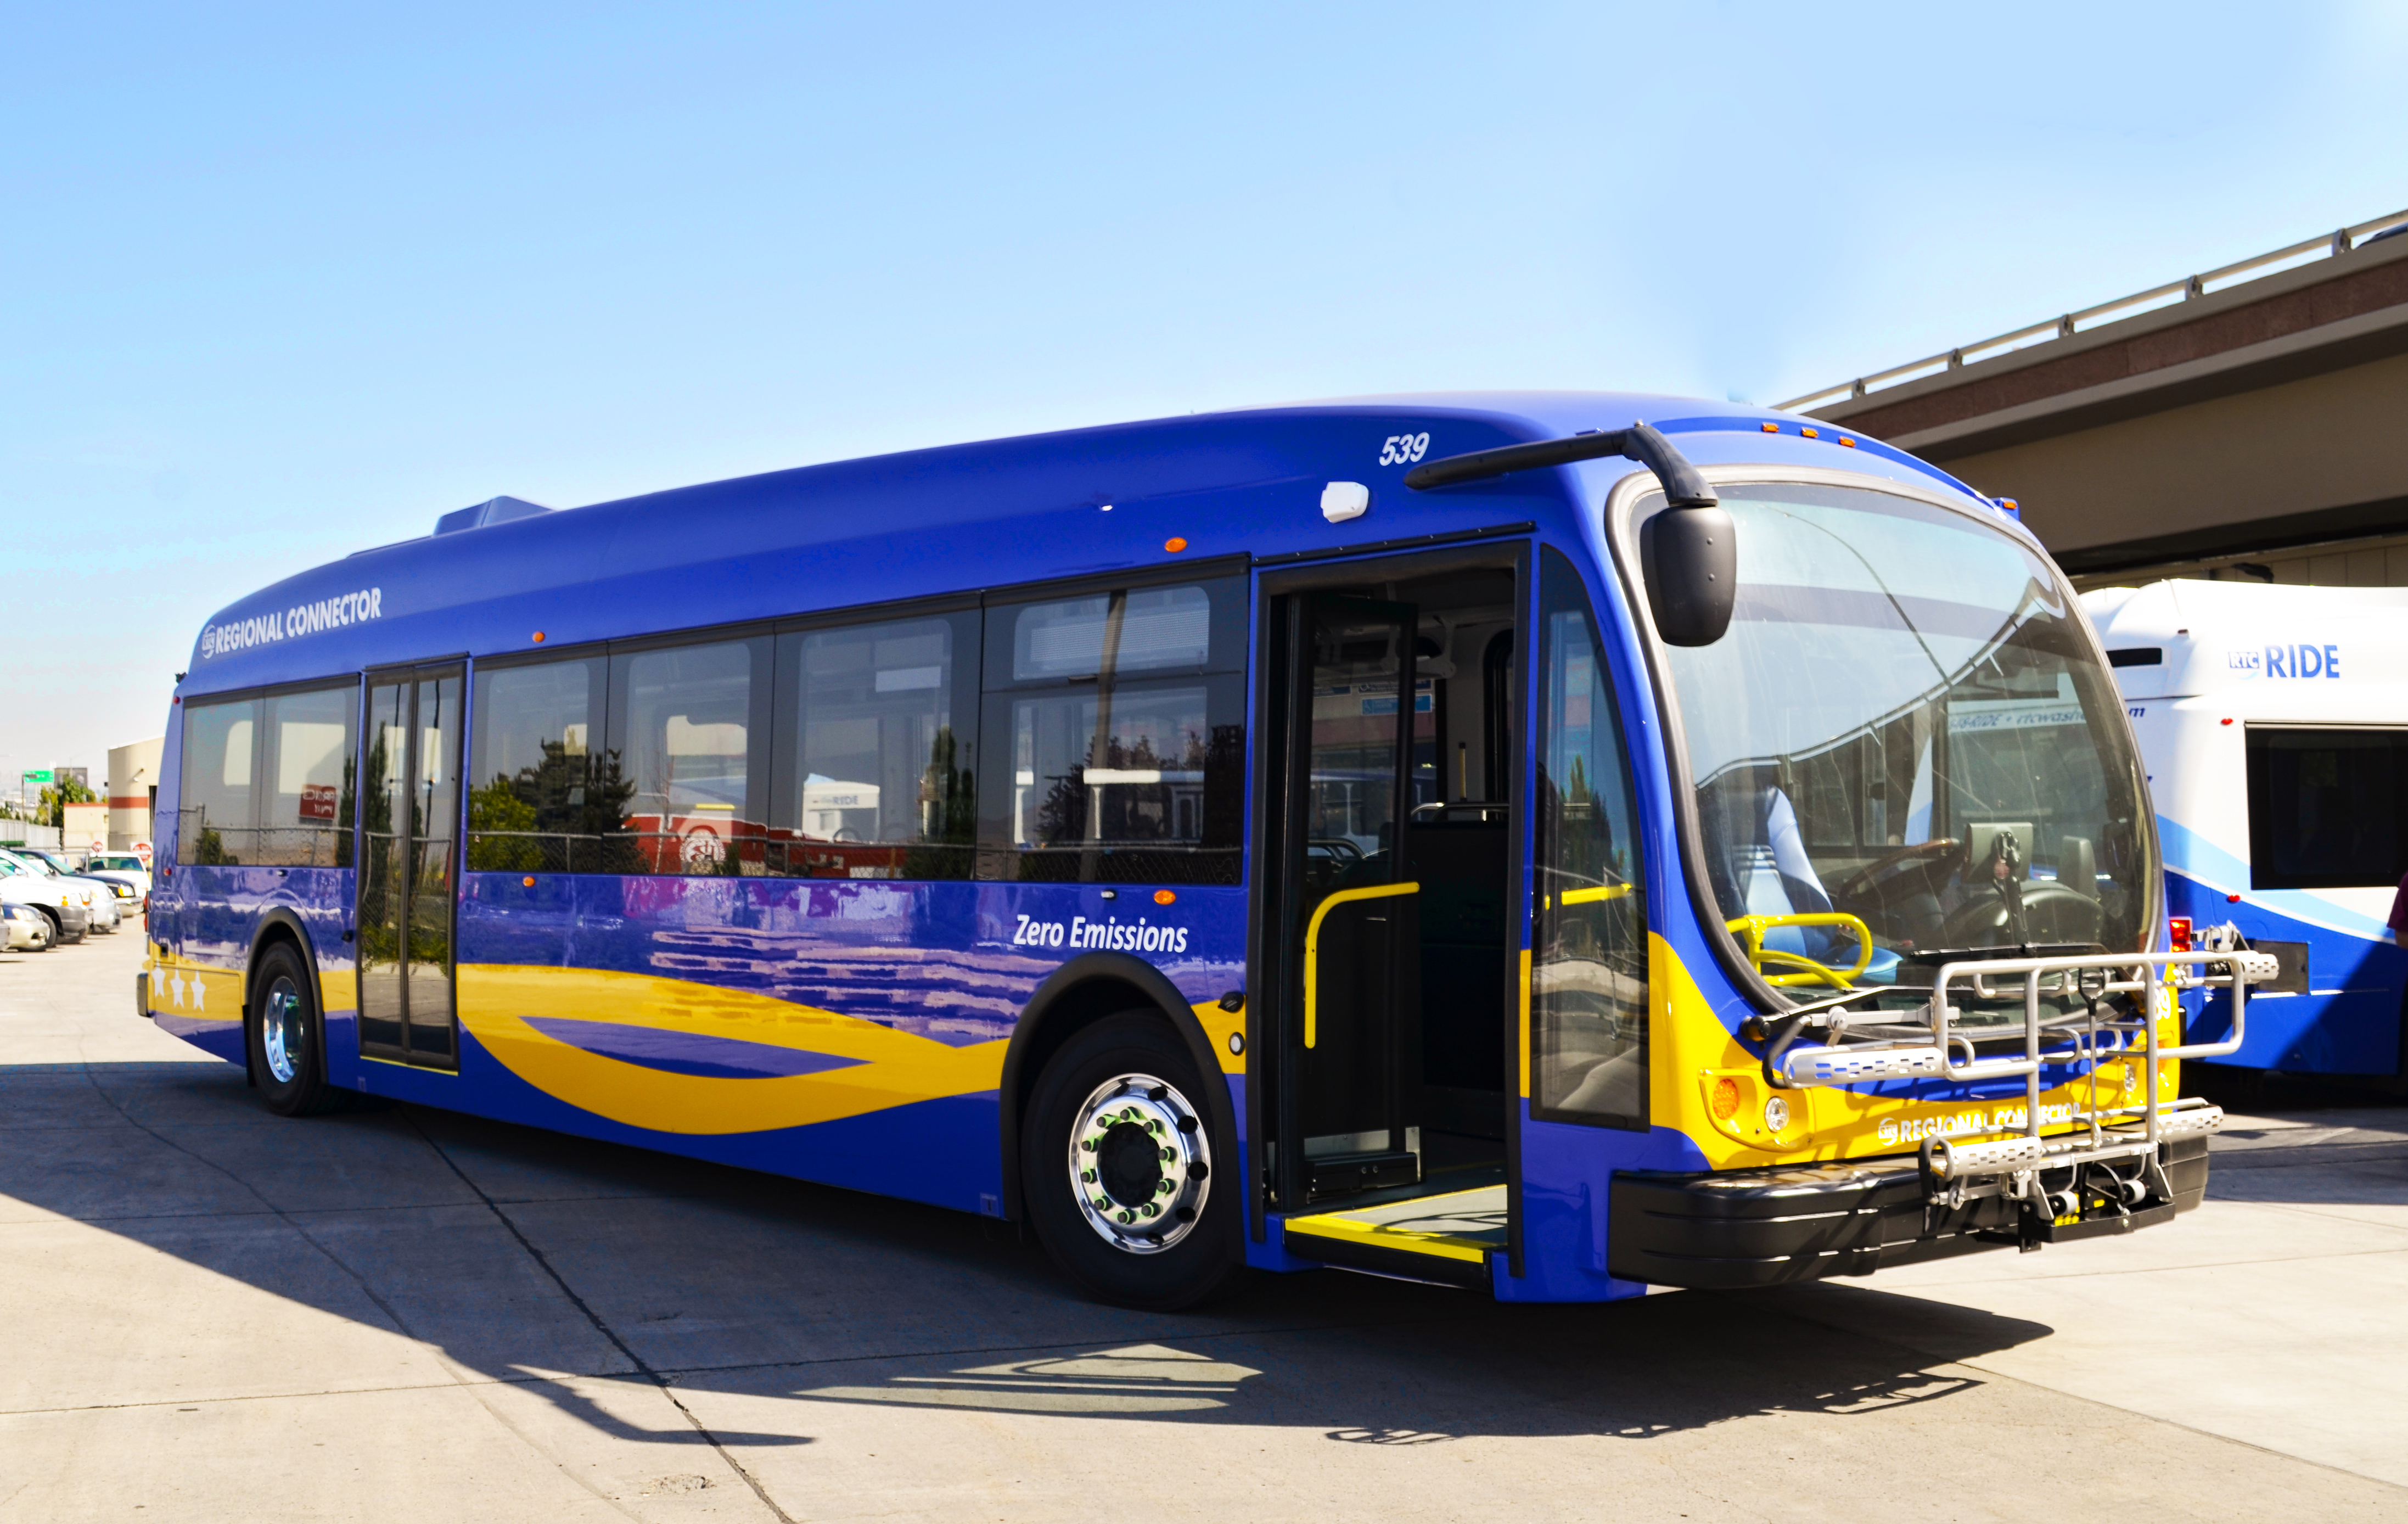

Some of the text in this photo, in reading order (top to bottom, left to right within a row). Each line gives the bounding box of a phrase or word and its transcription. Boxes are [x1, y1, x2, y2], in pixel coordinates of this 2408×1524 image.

[1379, 432, 1430, 466] 539
[215, 612, 284, 654] REGIONAL
[286, 587, 381, 638] CONNECTOR
[2229, 645, 2339, 678] RTC RIDE
[1013, 914, 1188, 953] Zero Emissions
[1900, 1113, 1988, 1143] REGIONAL
[1994, 1102, 2080, 1125] CONECTOR
